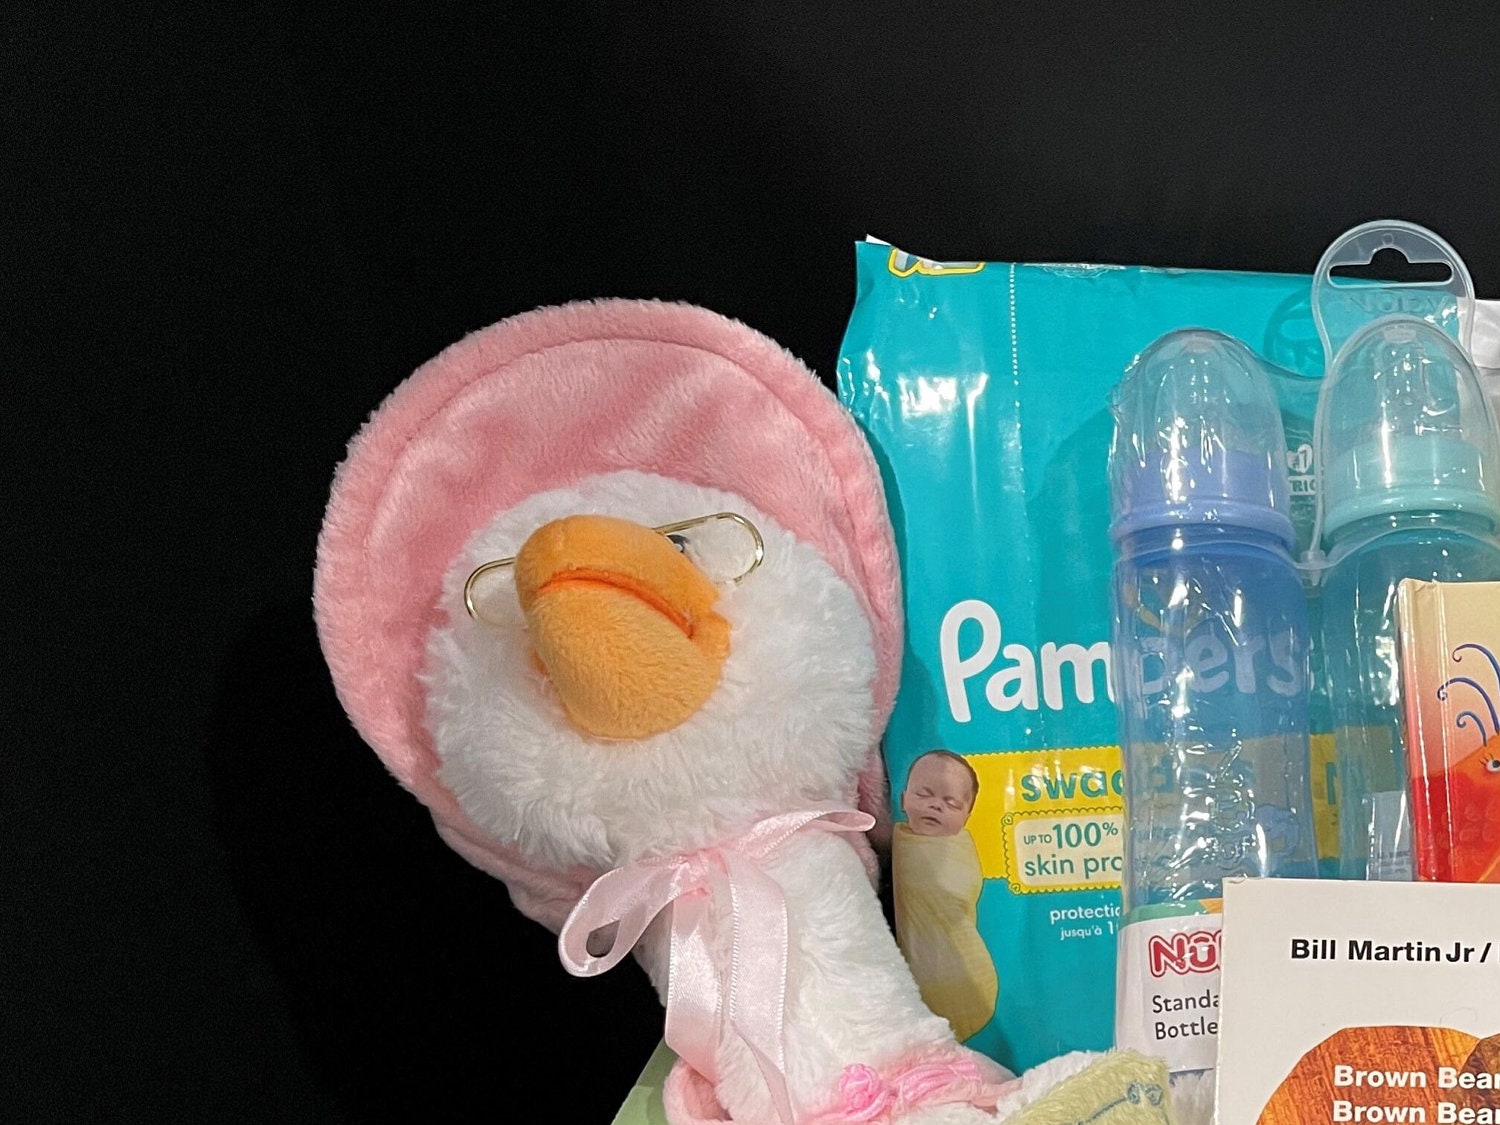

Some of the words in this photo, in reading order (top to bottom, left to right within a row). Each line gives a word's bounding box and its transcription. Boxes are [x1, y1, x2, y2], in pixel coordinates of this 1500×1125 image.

[939, 598, 1304, 723] Pampers
[1023, 835, 1037, 850] UP
[1038, 833, 1052, 849] TO
[1024, 853, 1074, 877] skin
[1291, 938, 1337, 961] Bill
[1348, 940, 1442, 963] Martin
[1445, 942, 1475, 964] Jr
[1479, 942, 1492, 965] /
[1154, 1015, 1219, 1040] Bottle
[1334, 1065, 1427, 1089] Brown
[1333, 1100, 1427, 1124] Brown
